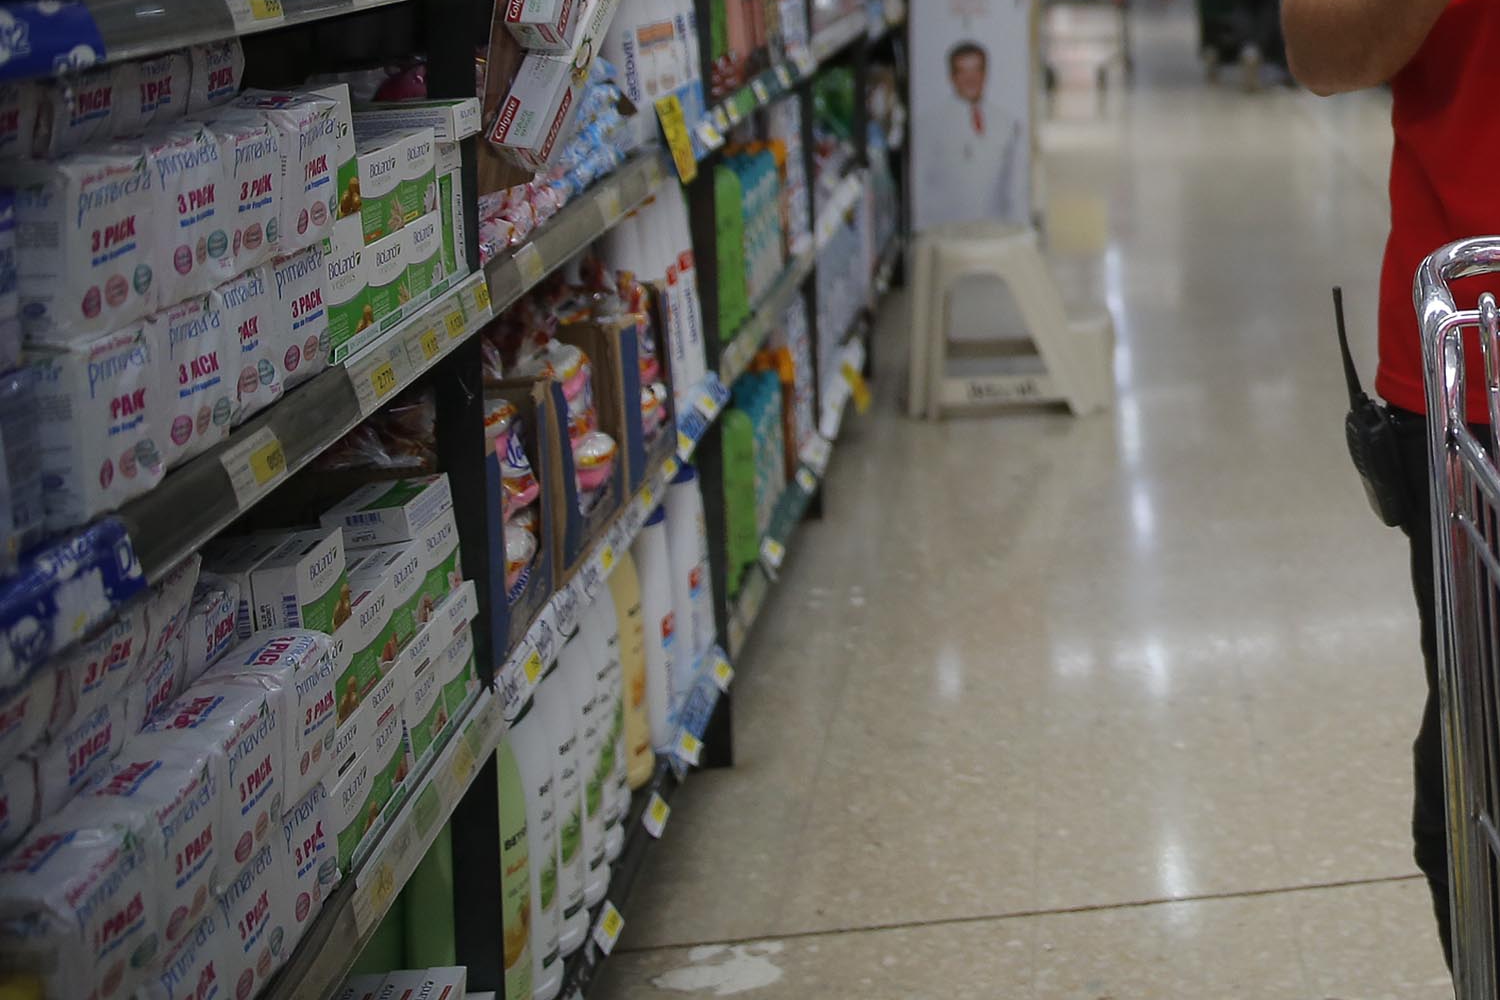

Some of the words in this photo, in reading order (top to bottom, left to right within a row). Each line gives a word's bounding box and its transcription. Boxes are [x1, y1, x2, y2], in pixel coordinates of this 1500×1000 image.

[495, 100, 517, 140] Colgate
[541, 94, 571, 158] Colgate
[291, 301, 299, 318] 3
[300, 288, 323, 315] PACK
